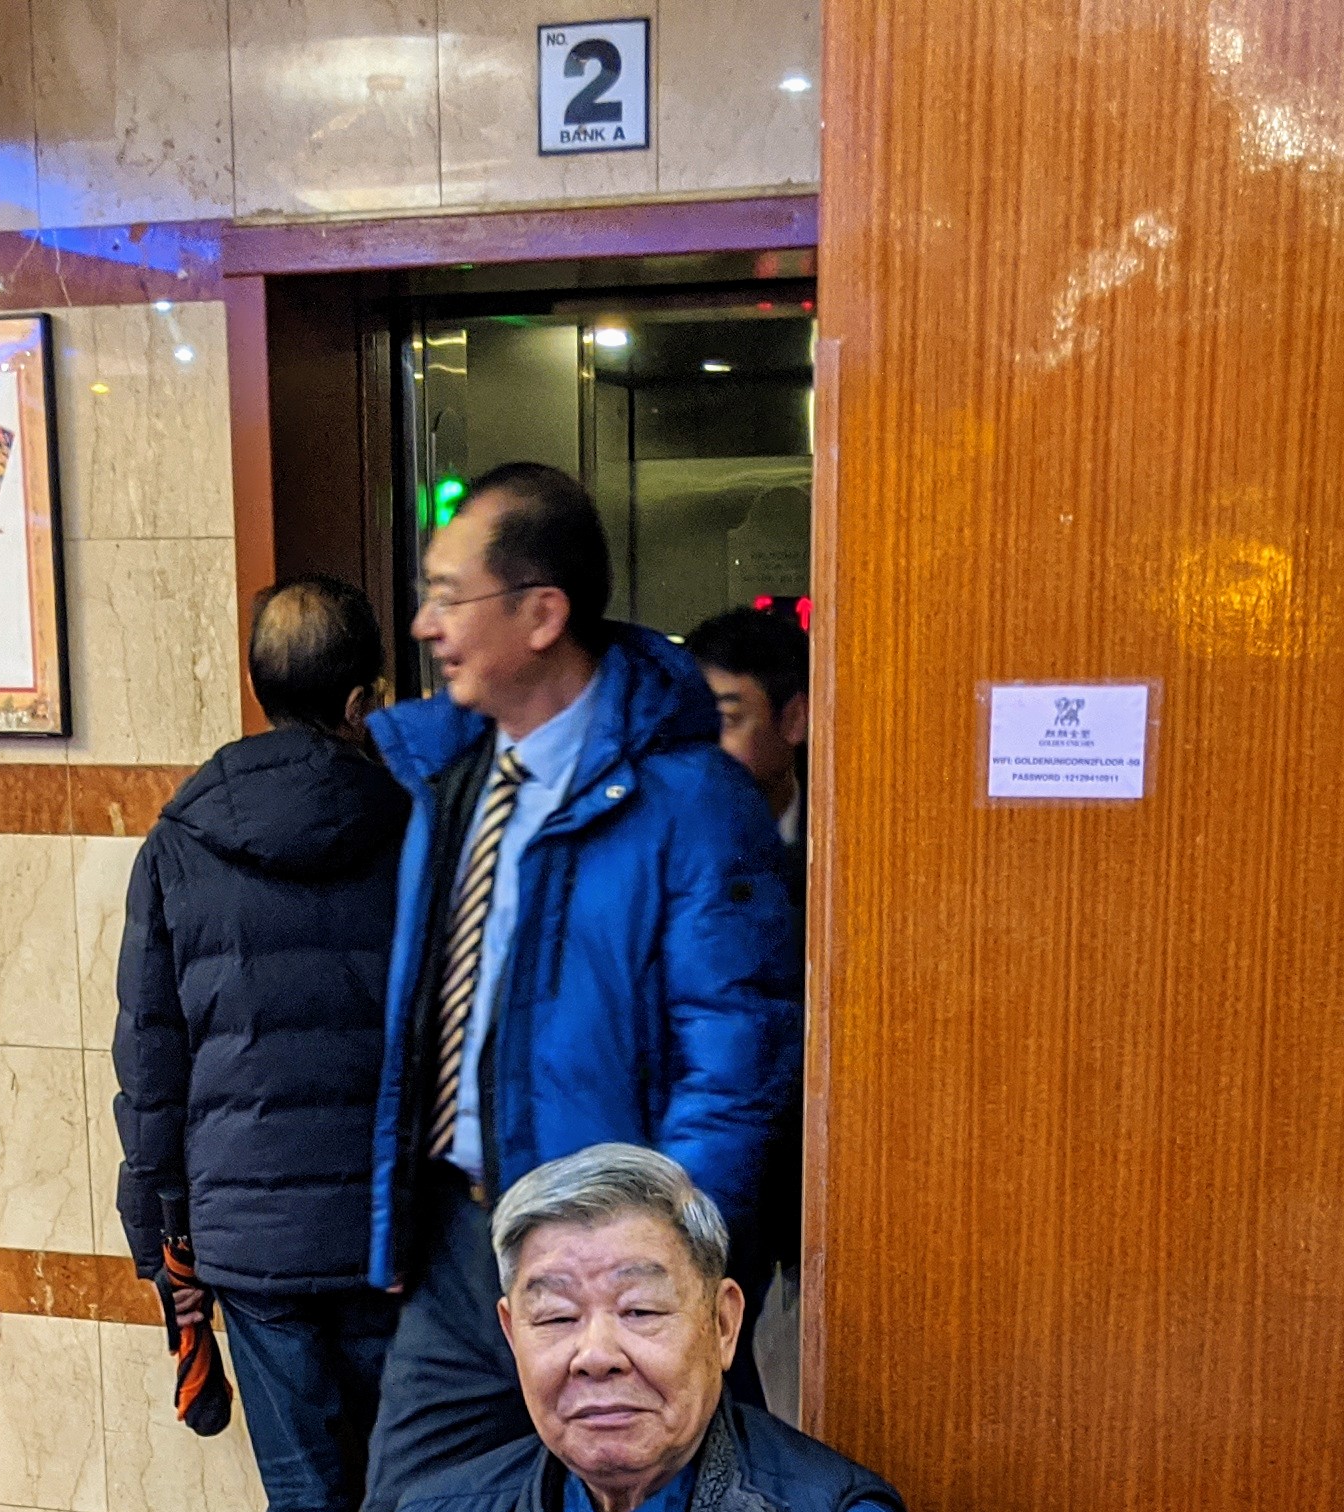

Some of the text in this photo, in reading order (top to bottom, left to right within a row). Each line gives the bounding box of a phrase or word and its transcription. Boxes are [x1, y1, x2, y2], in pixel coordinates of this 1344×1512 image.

[546, 33, 568, 46] NO.
[564, 38, 622, 126] 2
[560, 127, 626, 143] BANK A
